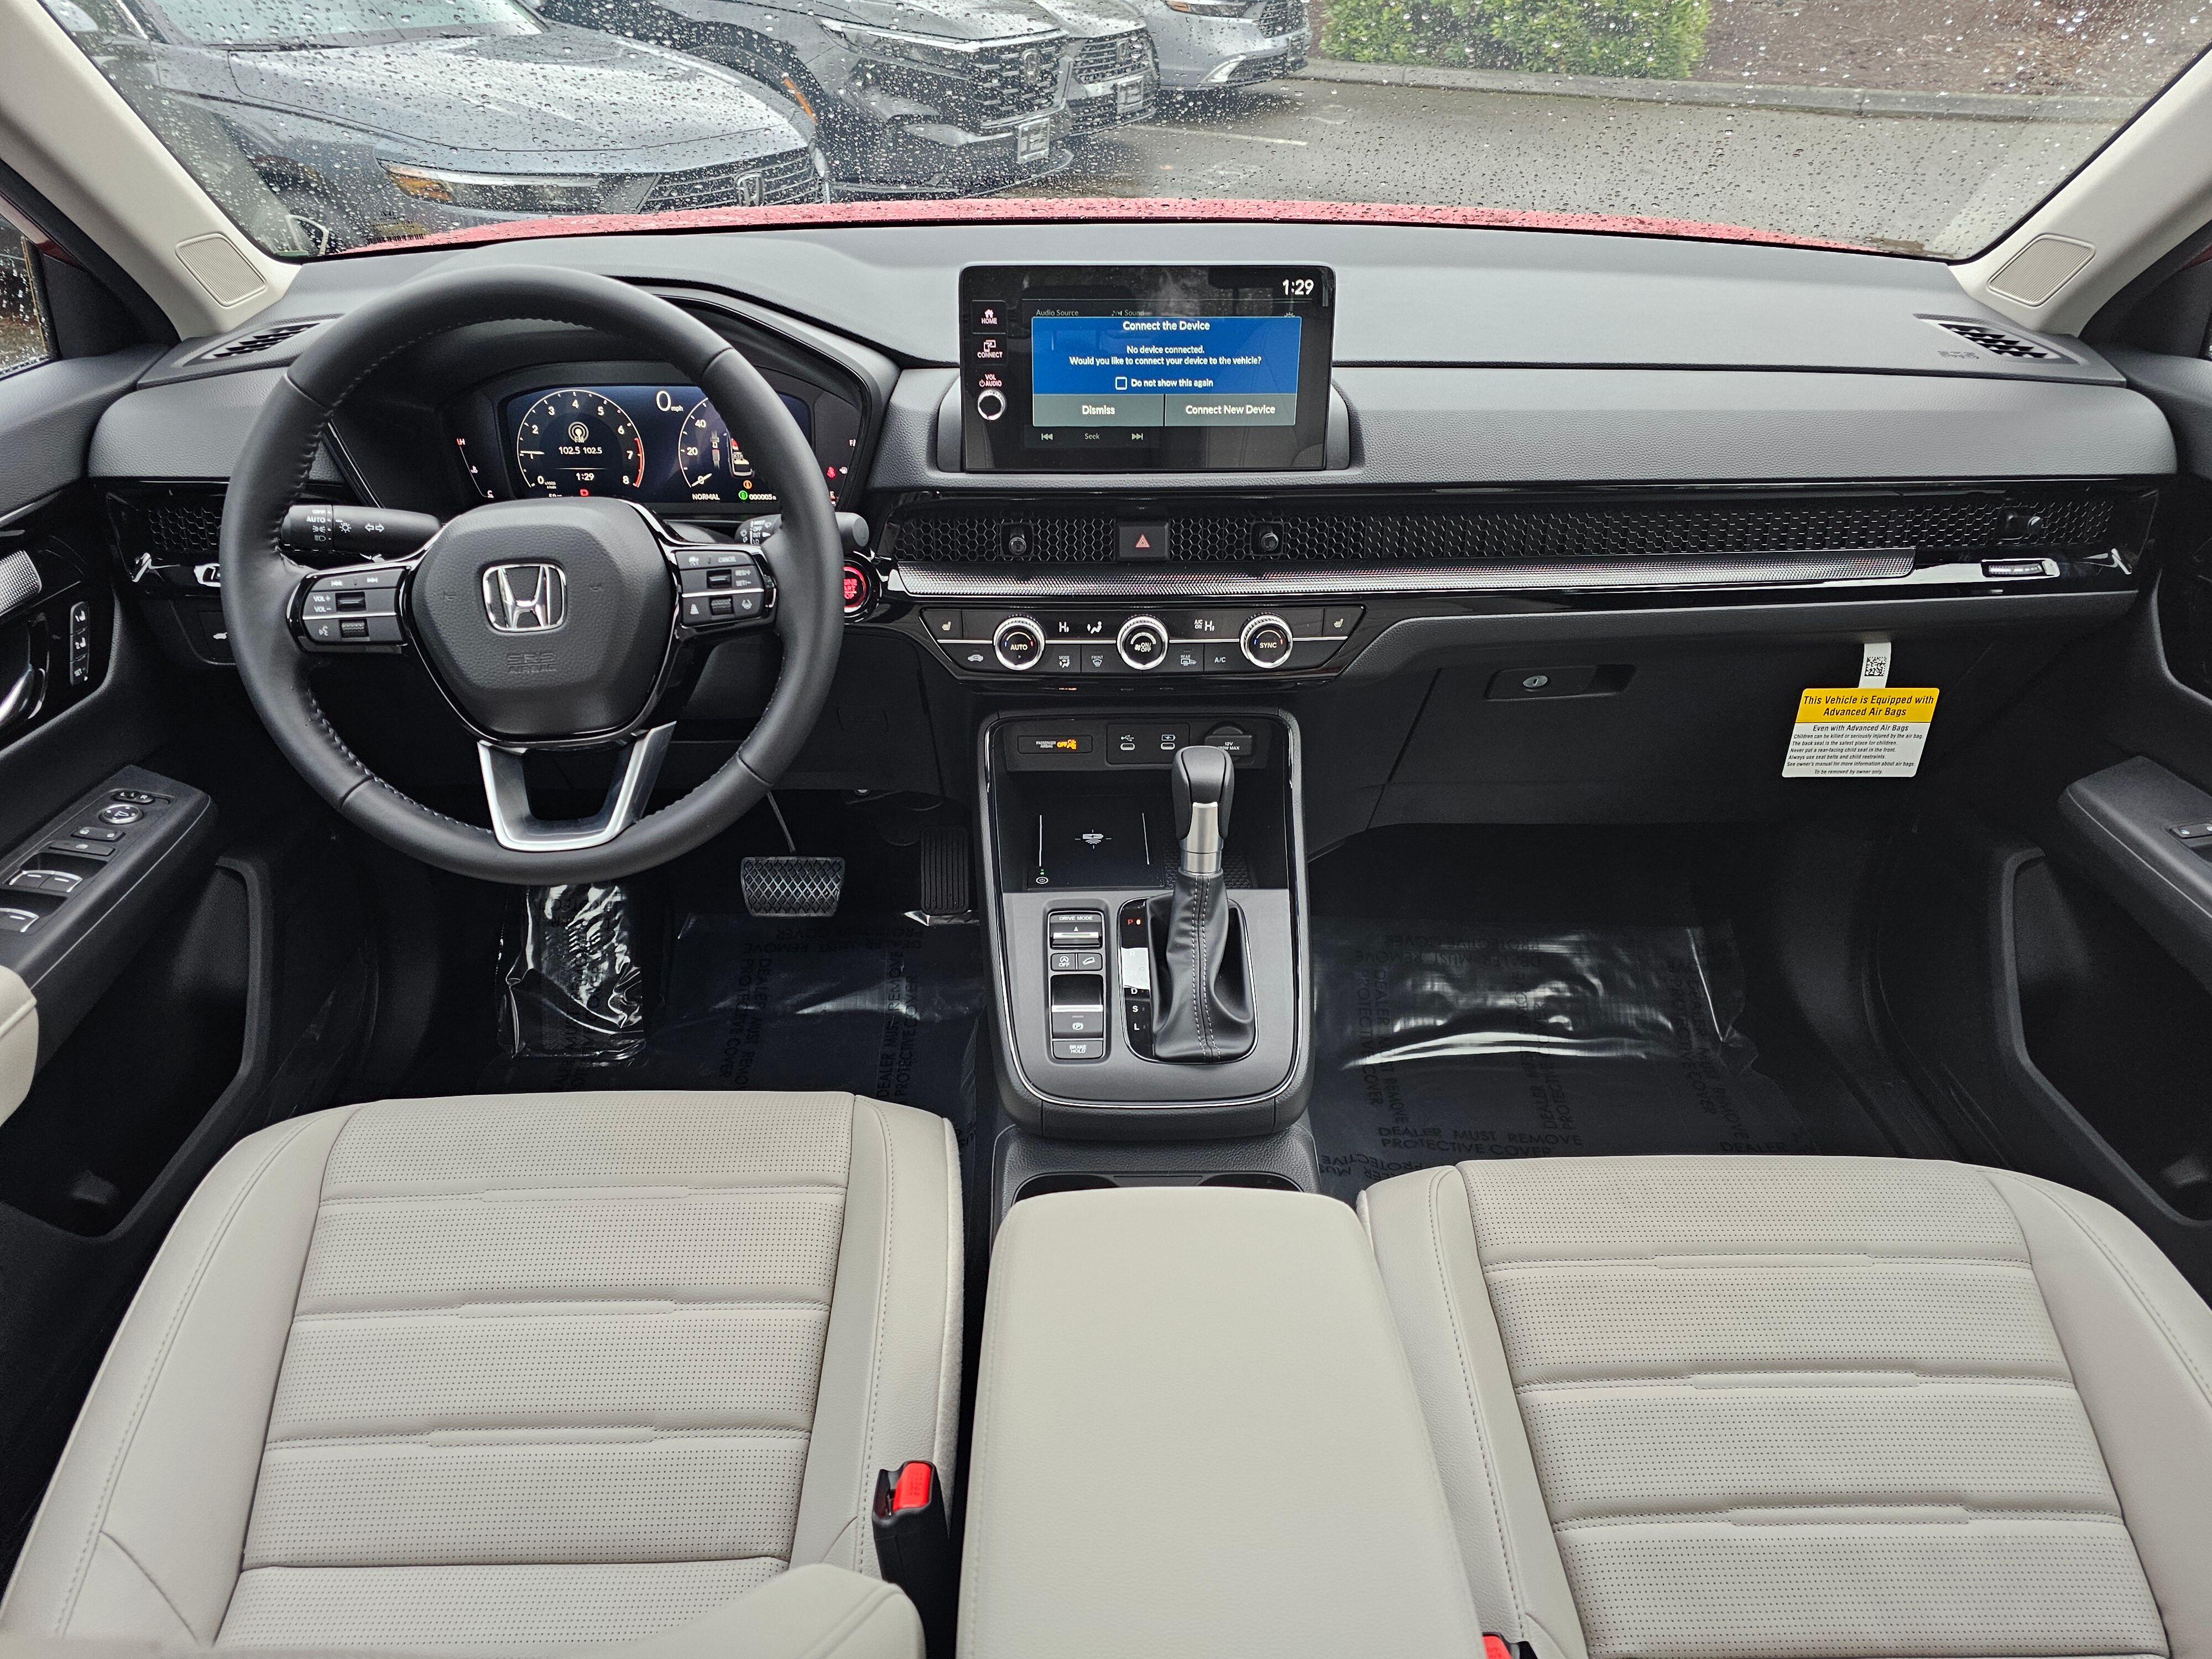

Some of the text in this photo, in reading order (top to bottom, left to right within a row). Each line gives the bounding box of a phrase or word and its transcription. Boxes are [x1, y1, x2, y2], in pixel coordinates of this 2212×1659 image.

[1282, 279, 1314, 295] 1:29
[1123, 321, 1210, 330] Connect the Device
[1126, 345, 1204, 354] No device connected.
[1069, 357, 1094, 365] Would
[1112, 356, 1124, 364] like
[1166, 358, 1183, 366] your
[1233, 356, 1262, 364] vehicle?
[1131, 379, 1213, 388] Do not show this again
[572, 399, 579, 409] 4
[656, 390, 671, 411] 0
[548, 406, 555, 415] 3
[597, 406, 604, 415] 5
[1082, 405, 1115, 415] Dismiss
[1186, 405, 1275, 414] Connect New Device
[695, 419, 706, 428] 40
[532, 424, 539, 435] 2
[618, 425, 624, 435] 6
[559, 446, 602, 455] 102.5 102.5
[627, 450, 633, 460] 7
[687, 447, 698, 456] 20
[537, 476, 544, 484] 0
[576, 472, 594, 481] 1:29
[622, 475, 629, 484] 8
[1871, 696, 1913, 705] Equipped
[1885, 707, 1907, 717] Bags
[1378, 1127, 1583, 1146] DEALER MUST REMOVE
[1381, 1139, 1551, 1156] PROTECTIVE COVER
